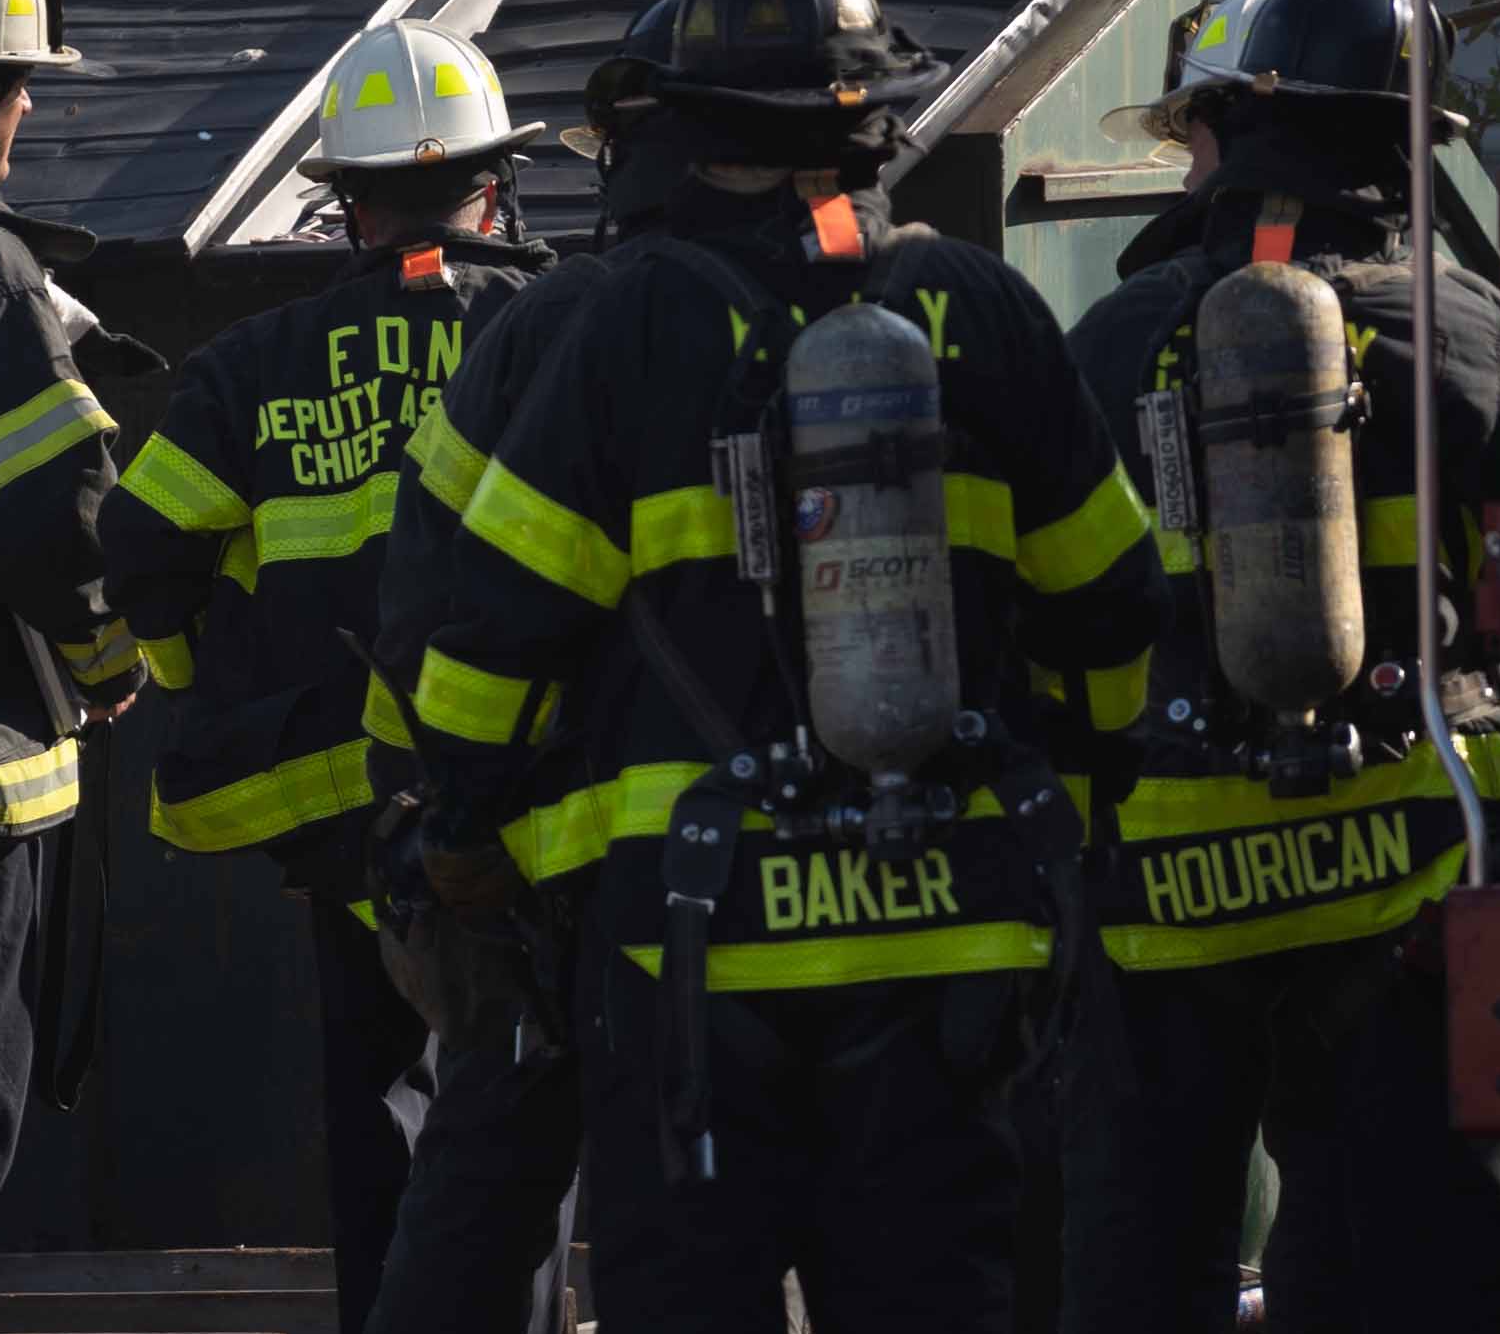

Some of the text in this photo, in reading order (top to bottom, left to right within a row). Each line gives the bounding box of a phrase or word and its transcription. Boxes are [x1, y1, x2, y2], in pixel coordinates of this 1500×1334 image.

[328, 317, 463, 388] F.D.N
[256, 379, 382, 450] DEPUTY
[291, 418, 393, 486] CHIEF
[848, 553, 930, 579] SCOTT
[760, 850, 959, 932] BAKER
[1142, 809, 1412, 925] HOURICAN
